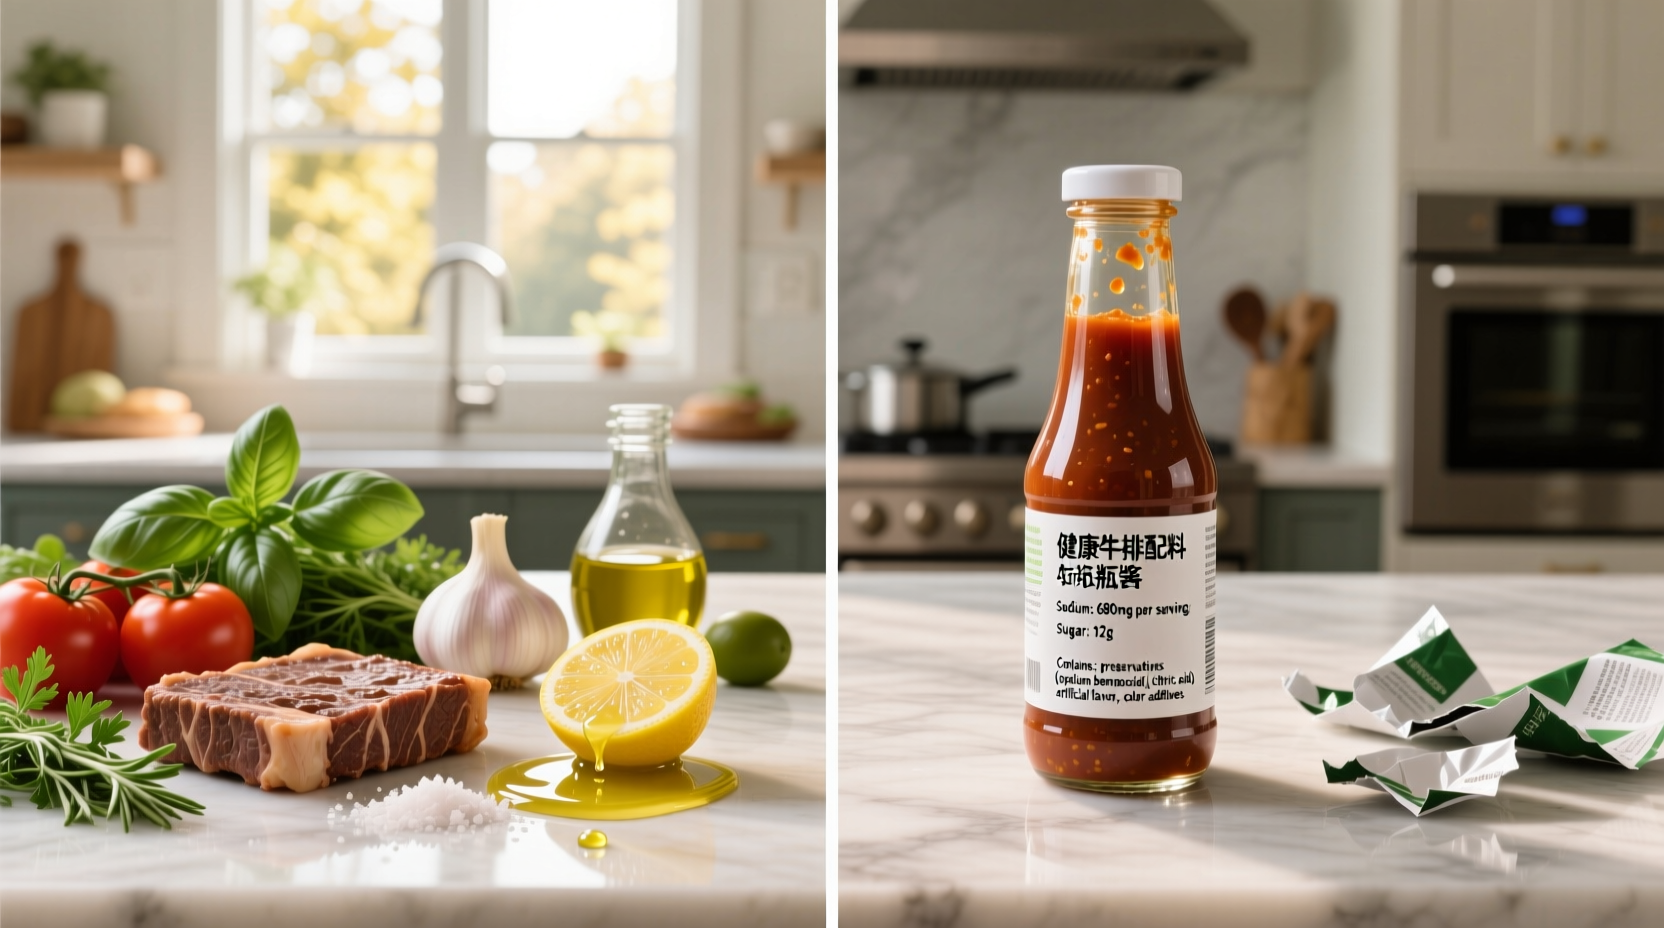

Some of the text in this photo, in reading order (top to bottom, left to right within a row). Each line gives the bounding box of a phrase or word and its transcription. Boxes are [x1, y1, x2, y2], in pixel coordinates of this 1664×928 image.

[1057, 532, 1186, 561] 健康牛排配料
[1135, 605, 1153, 619] per
[1056, 623, 1114, 641] Sugar: 12g
